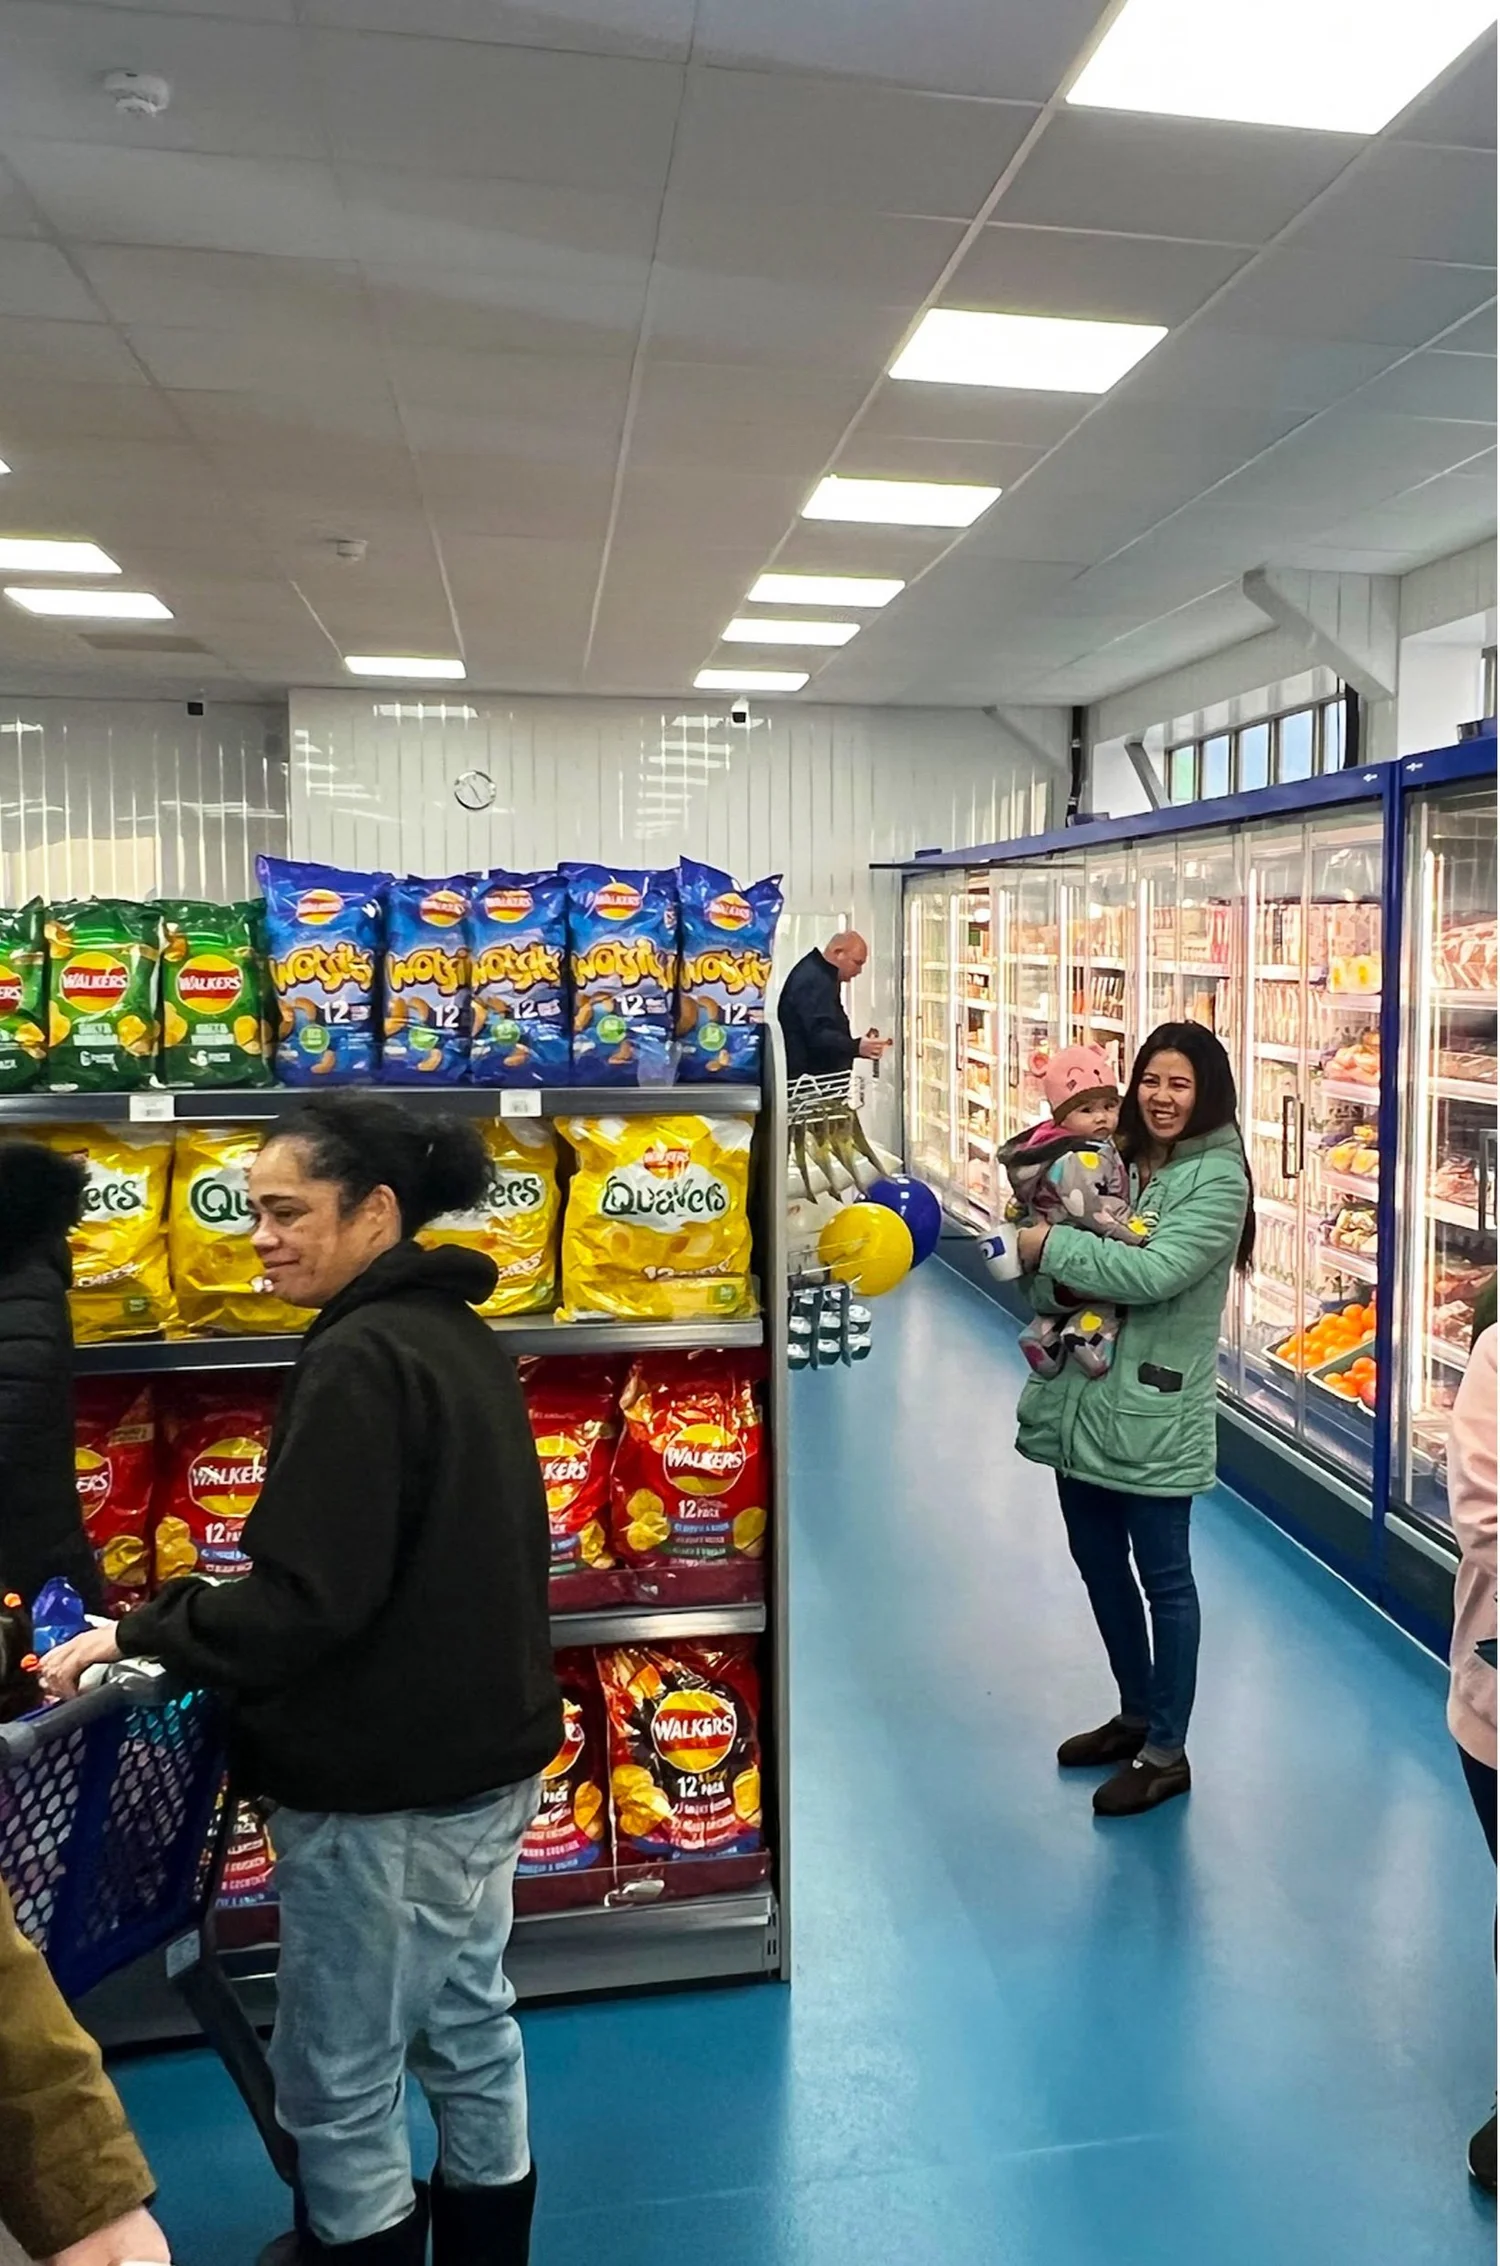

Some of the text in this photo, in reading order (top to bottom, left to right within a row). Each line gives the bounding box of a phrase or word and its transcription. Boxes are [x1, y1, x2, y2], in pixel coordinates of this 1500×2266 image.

[62, 972, 127, 989] WALKERS
[179, 976, 242, 991] WALKERS
[322, 1000, 350, 1024] 12
[434, 1004, 460, 1028] 12
[511, 1000, 538, 1019] 12
[616, 994, 646, 1017] 12
[722, 1002, 748, 1024] 12
[602, 1176, 727, 1216] Quavers
[667, 1446, 743, 1470] WALKERS
[192, 1465, 267, 1487] WALKER
[678, 1499, 697, 1519] 12
[205, 1522, 226, 1544] 12
[654, 1714, 734, 1742] WALKERS
[677, 1775, 698, 1799] 12
